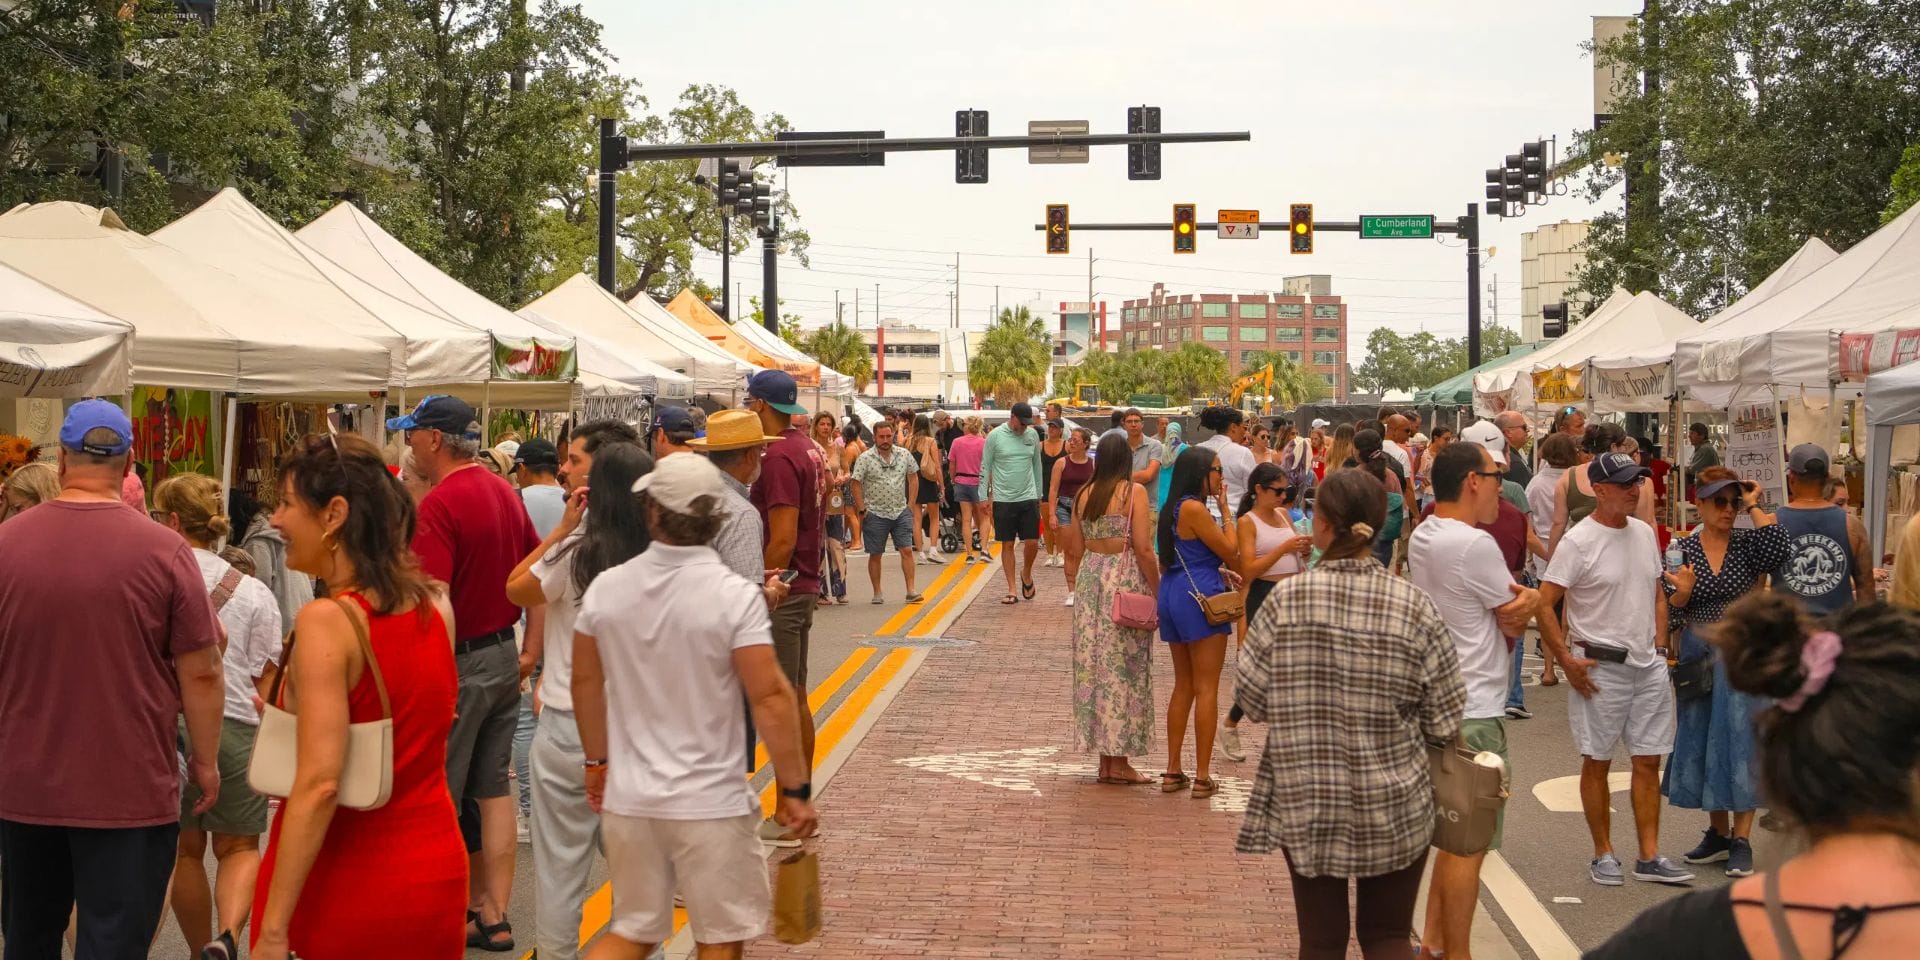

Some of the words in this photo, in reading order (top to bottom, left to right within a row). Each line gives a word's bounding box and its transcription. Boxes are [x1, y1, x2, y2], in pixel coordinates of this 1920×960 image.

[1367, 220, 1372, 228] E
[1375, 218, 1427, 228] Cumberland
[1741, 432, 1773, 442] TAMPA
[1732, 451, 1775, 468] BOOK
[1799, 535, 1844, 562] WEEKEND
[1784, 572, 1802, 591] HAS
[1802, 572, 1842, 595] ARRIVED
[1436, 805, 1460, 823] AG
